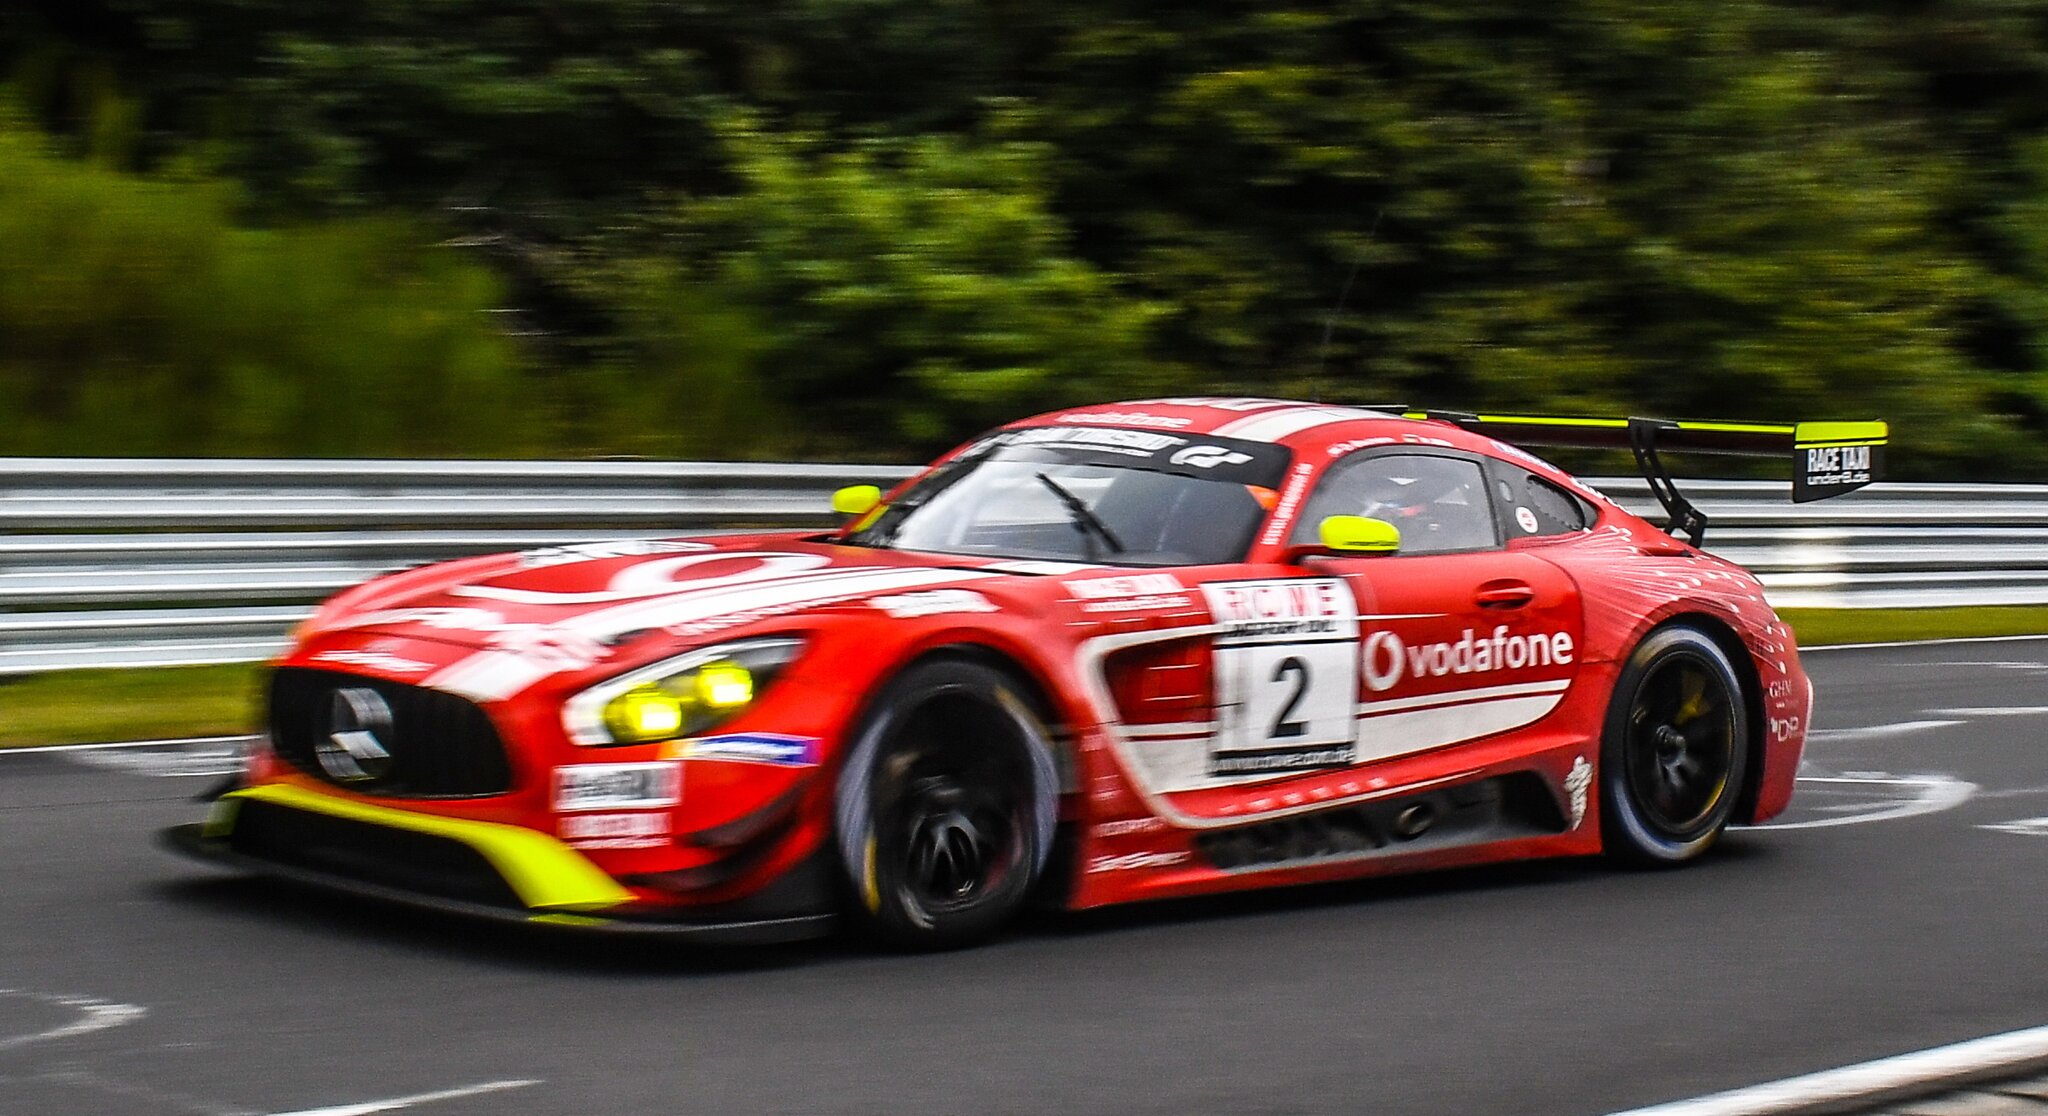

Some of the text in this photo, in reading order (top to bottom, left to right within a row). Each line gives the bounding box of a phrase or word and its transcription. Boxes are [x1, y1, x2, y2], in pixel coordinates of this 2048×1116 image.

[1807, 448, 1841, 472] RACE
[1406, 625, 1574, 678] vodafone
[1266, 656, 1313, 739] 2
